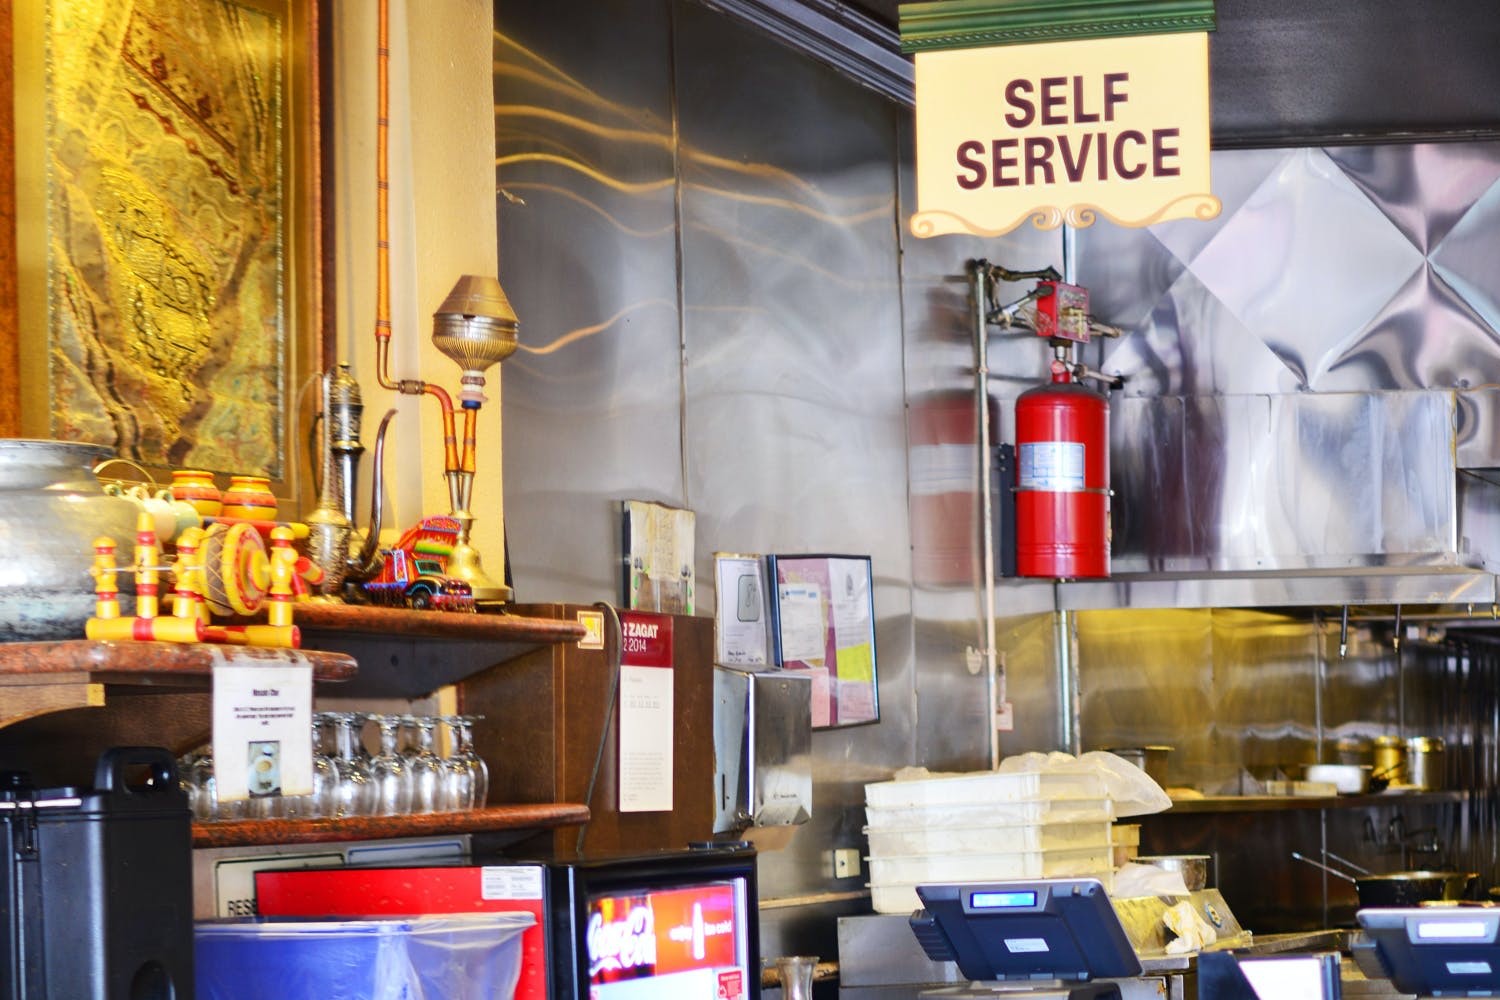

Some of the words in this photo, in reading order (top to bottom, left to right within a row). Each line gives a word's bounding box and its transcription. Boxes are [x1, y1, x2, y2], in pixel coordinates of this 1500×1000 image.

[1004, 72, 1130, 130] SELF
[956, 127, 1182, 190] SERVICE
[628, 638, 647, 653] 2014
[629, 622, 659, 639] ZAGAT
